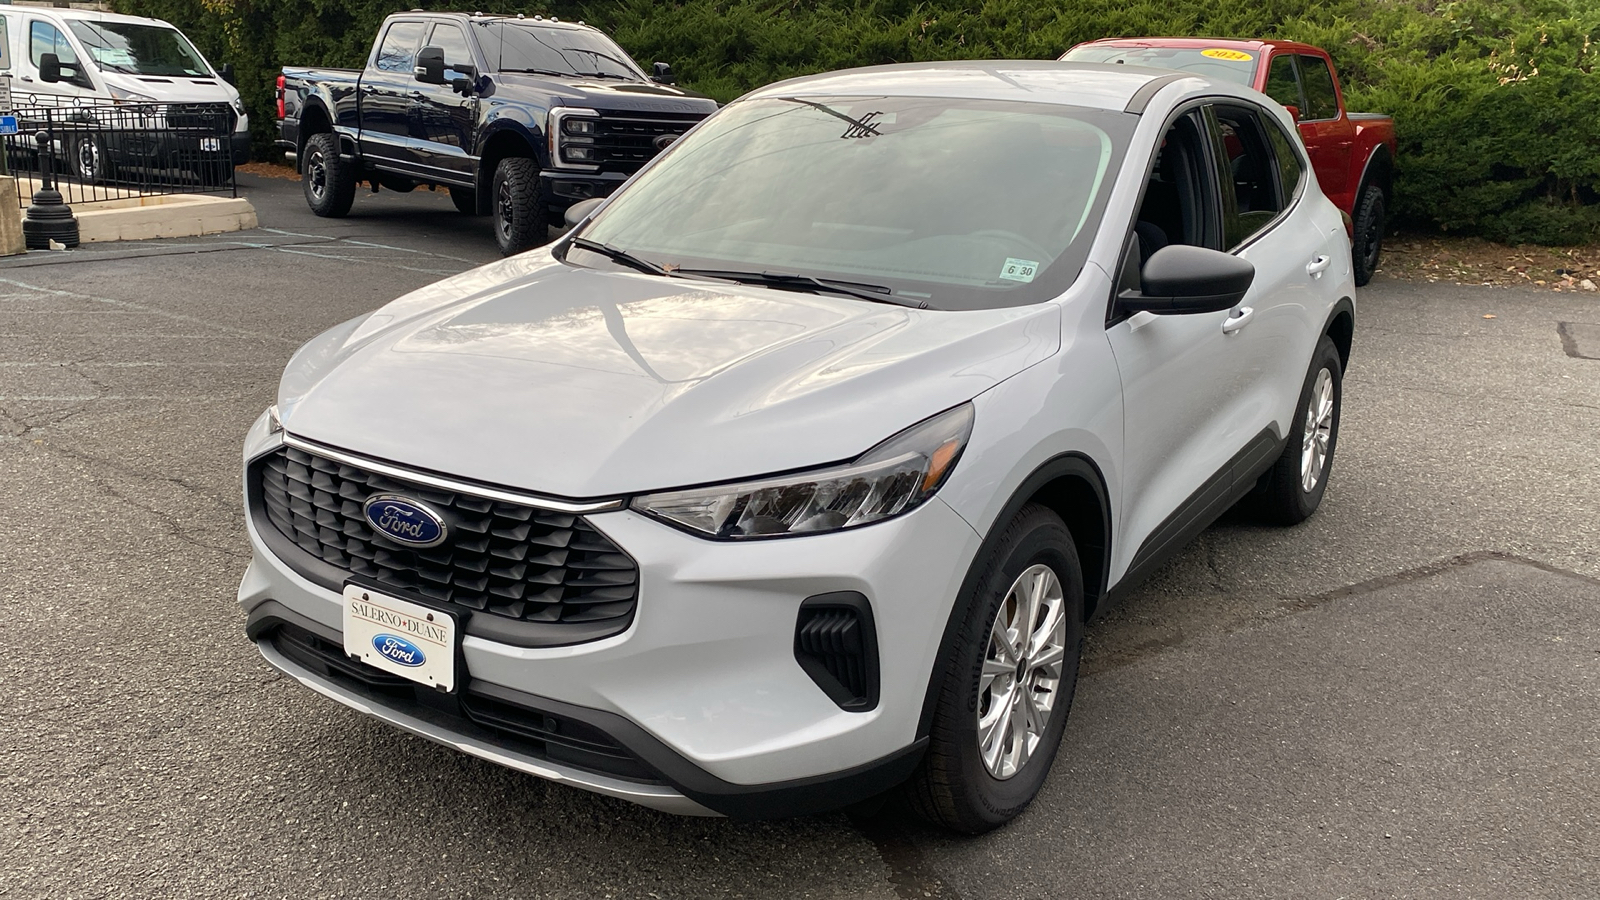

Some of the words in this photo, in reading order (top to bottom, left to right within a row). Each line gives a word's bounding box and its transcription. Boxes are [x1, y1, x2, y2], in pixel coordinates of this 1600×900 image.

[1008, 266, 1016, 274] 6
[1020, 267, 1033, 276] 30
[378, 505, 424, 538] Ford
[351, 602, 402, 628] SALERNO
[407, 618, 447, 644] DUANE
[382, 637, 415, 664] Ford
